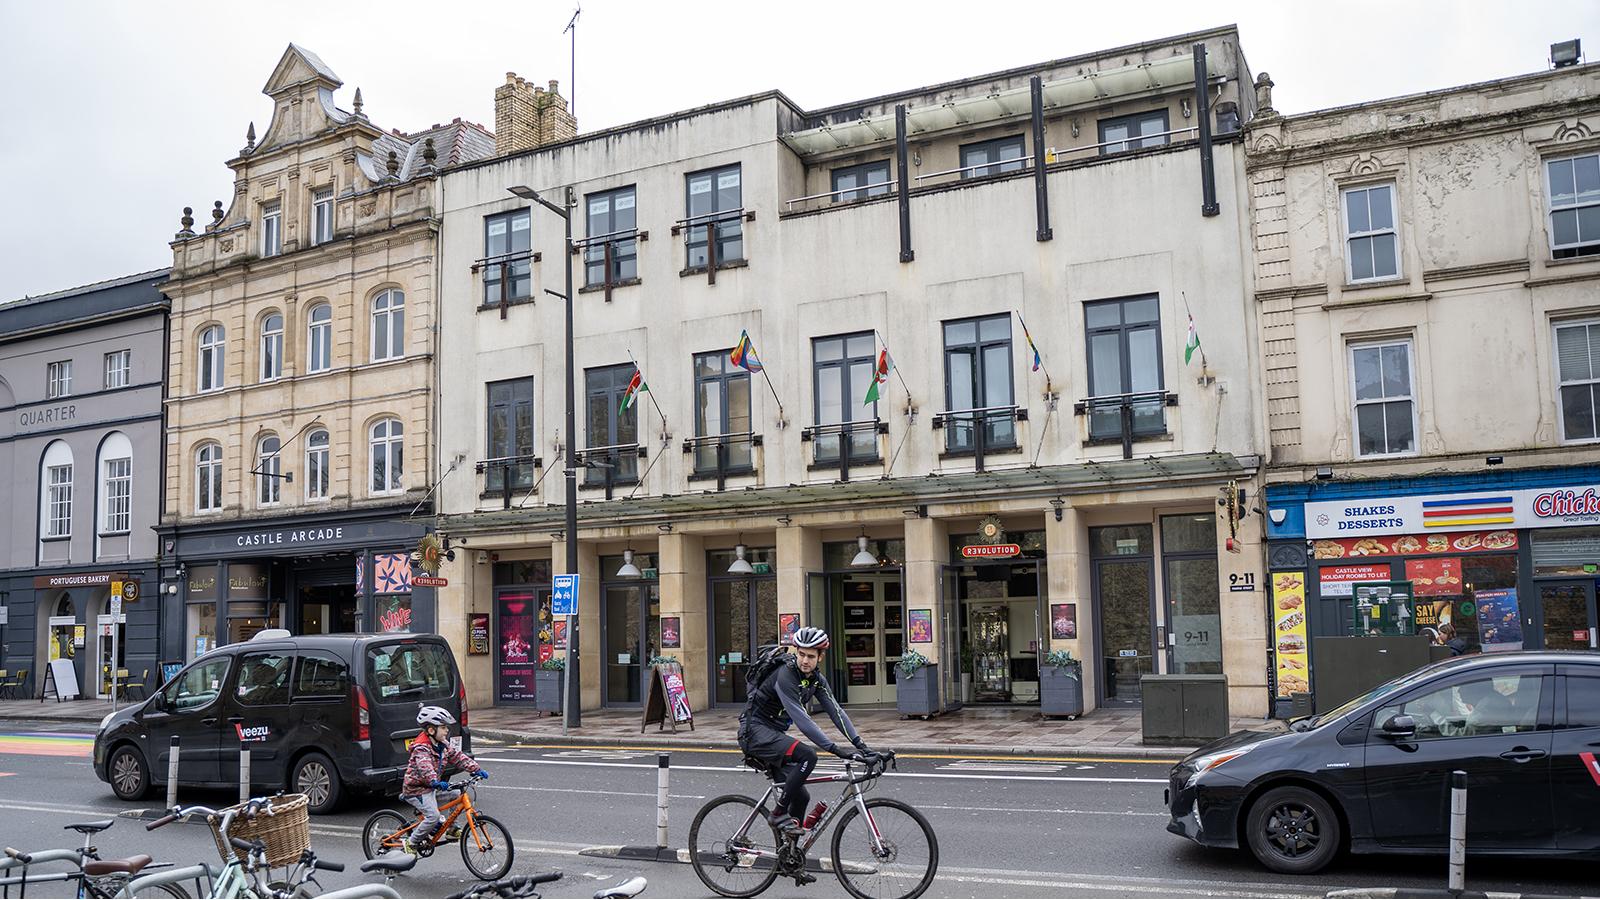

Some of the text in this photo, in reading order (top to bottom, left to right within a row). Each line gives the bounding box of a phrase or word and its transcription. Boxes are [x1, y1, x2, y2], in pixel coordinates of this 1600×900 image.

[20, 405, 76, 426] QUARTER
[1533, 488, 1600, 518] Chick
[1344, 505, 1395, 517] SHAKES
[1338, 518, 1404, 530] DESSERTS
[237, 528, 342, 546] CASTLE ARCADE
[50, 575, 110, 585] PORTUGUESE BAKERY
[1229, 573, 1255, 585] 9-11
[1416, 604, 1434, 617] SAY
[380, 607, 412, 632] WINE
[1415, 616, 1436, 625] CHEESE
[1184, 631, 1209, 642] 9-11
